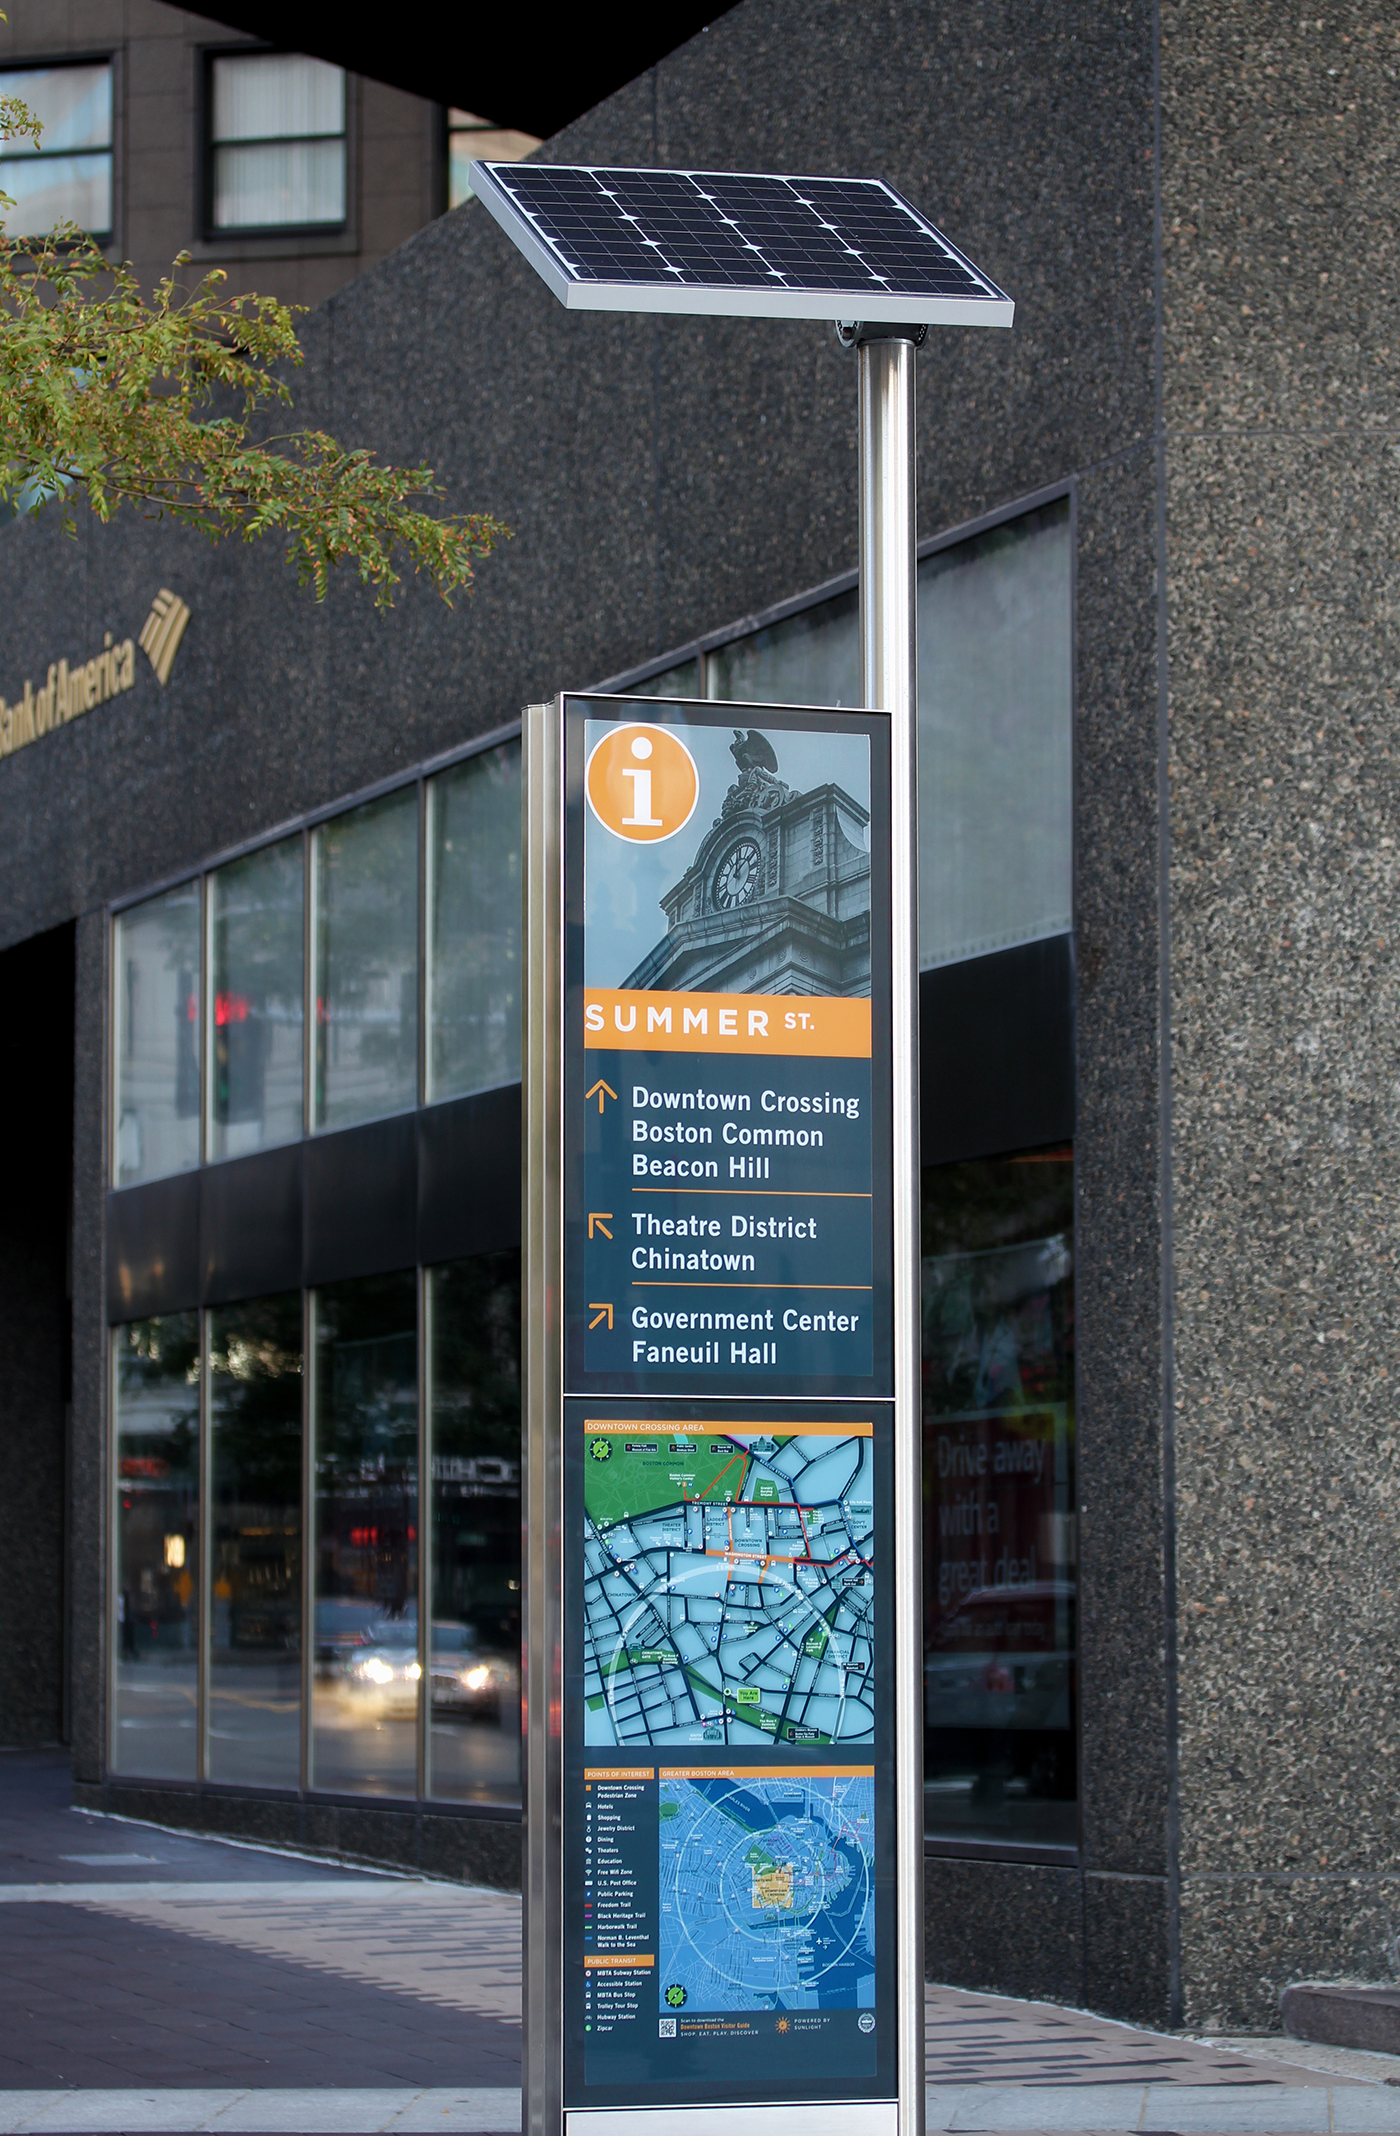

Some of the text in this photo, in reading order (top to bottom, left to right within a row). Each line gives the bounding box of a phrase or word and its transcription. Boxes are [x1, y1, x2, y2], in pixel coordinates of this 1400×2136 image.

[36, 663, 57, 737] of
[55, 631, 135, 726] America
[585, 1003, 815, 1037] SUMMER ST.
[632, 1086, 860, 1119] Downtown Crossing
[632, 1120, 824, 1146] Boston Common
[632, 1154, 770, 1179] Beacon Hill
[632, 1213, 817, 1239] Theatre District
[632, 1247, 755, 1271] Chinatown
[631, 1306, 859, 1332] Government Center
[632, 1340, 777, 1364] Faneuil Hall
[587, 1423, 705, 1432] DOWNTOWN CROSSING AREA
[938, 1435, 1045, 1484] Drive away
[939, 1492, 999, 1536] with a
[939, 1544, 1036, 1606] great deal
